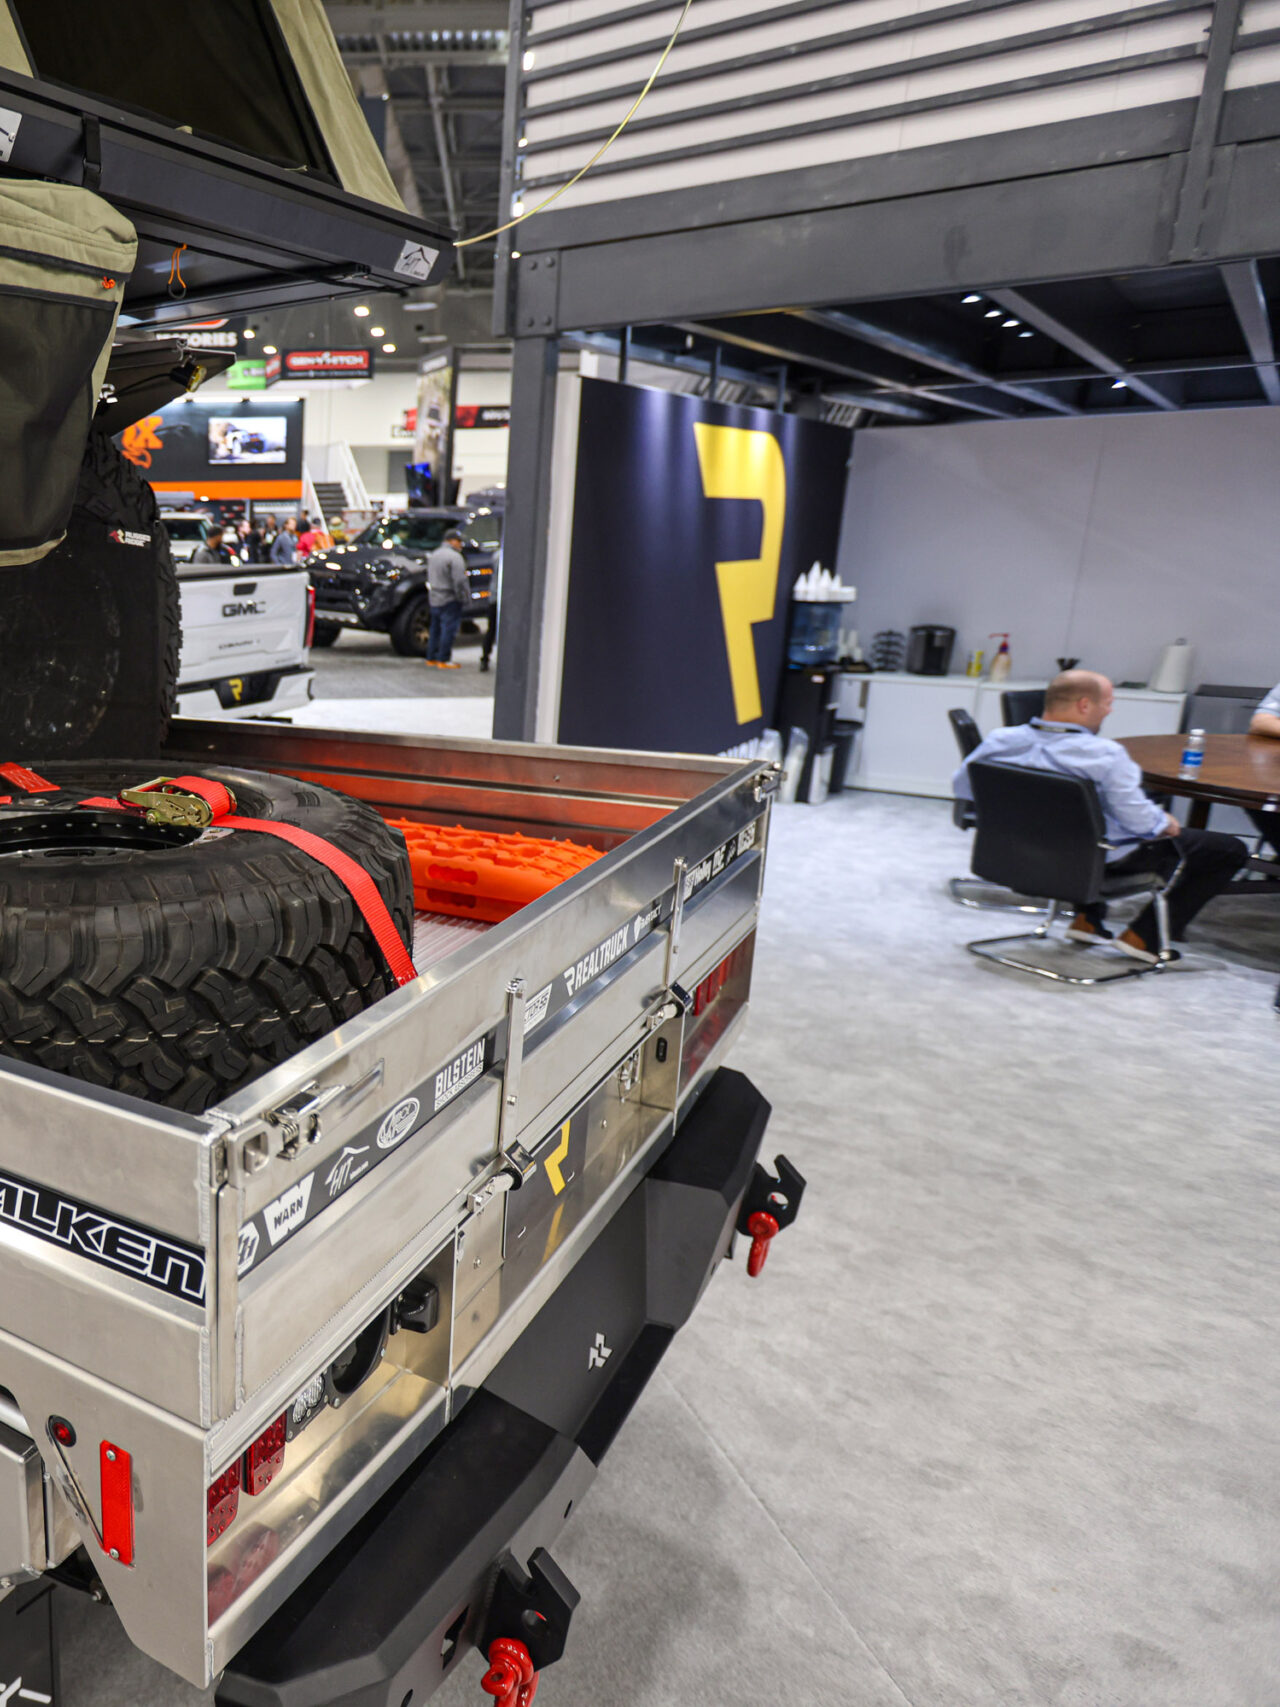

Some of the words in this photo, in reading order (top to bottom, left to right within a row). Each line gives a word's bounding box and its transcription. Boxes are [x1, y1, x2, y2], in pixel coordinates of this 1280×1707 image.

[221, 600, 267, 618] GMC
[574, 923, 630, 991] REALTRUCK
[434, 1037, 486, 1100] BILSTEIN
[273, 1195, 304, 1230] WARN
